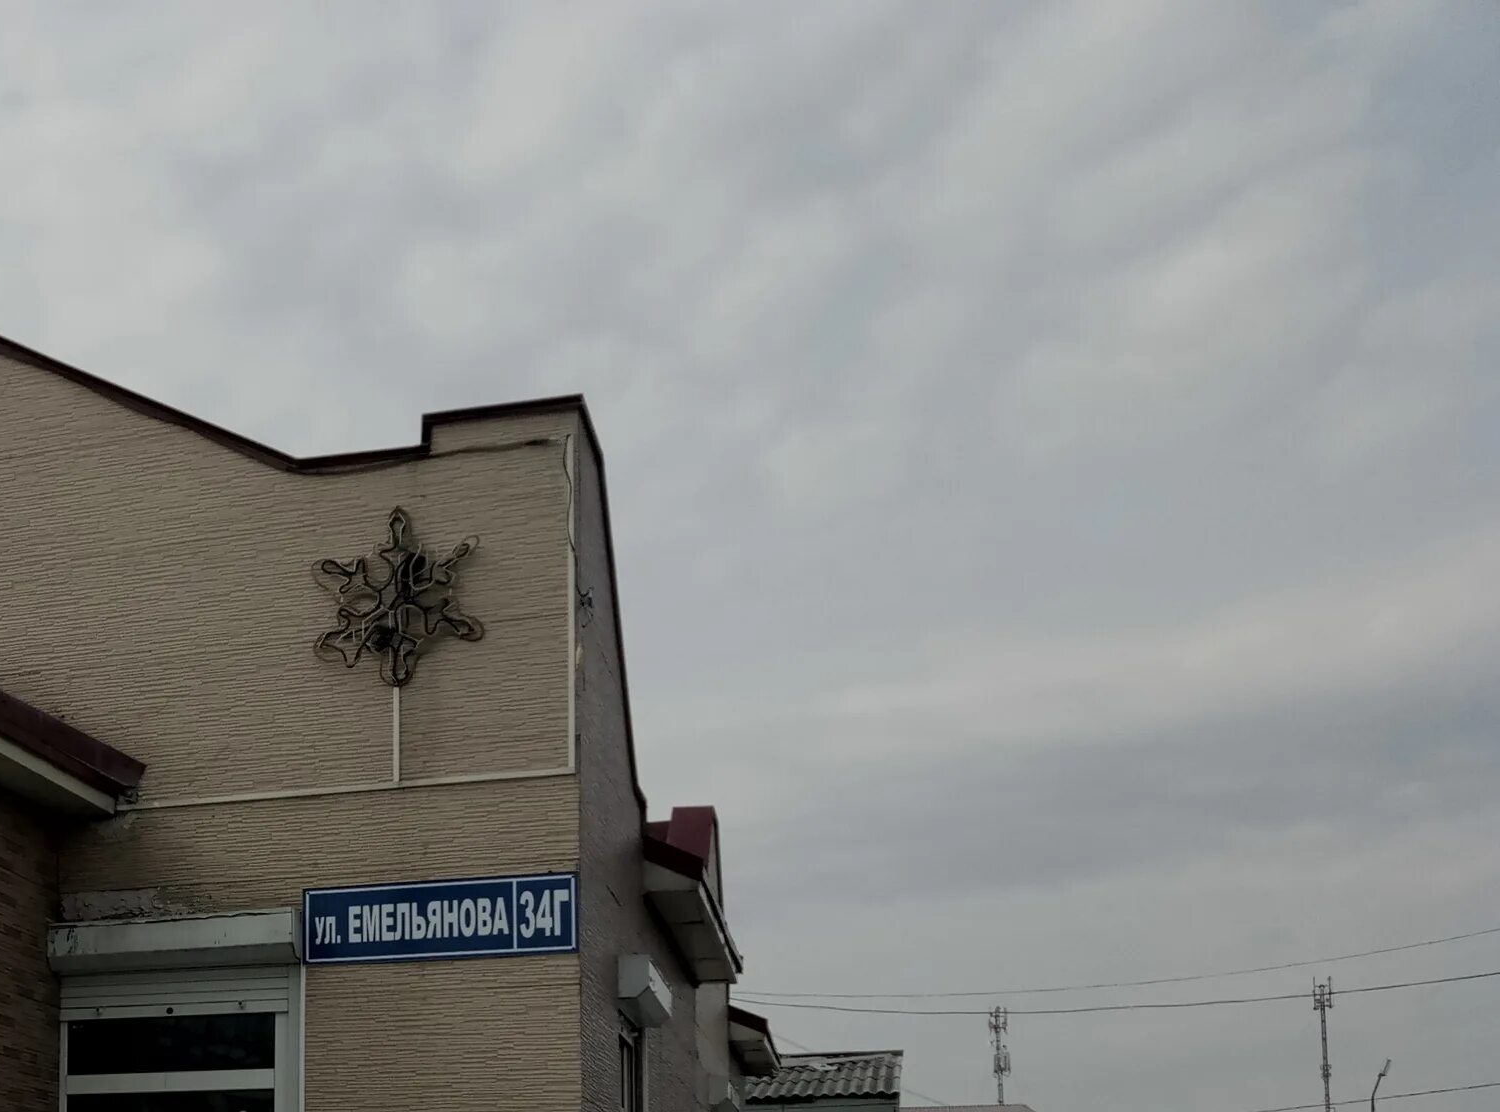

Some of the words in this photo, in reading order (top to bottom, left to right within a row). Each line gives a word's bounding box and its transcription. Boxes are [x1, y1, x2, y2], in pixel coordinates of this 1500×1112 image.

[314, 915, 342, 945] ул.
[348, 896, 510, 944] ЕМЕЛЬЯНОВА
[519, 888, 570, 938] 34Г
